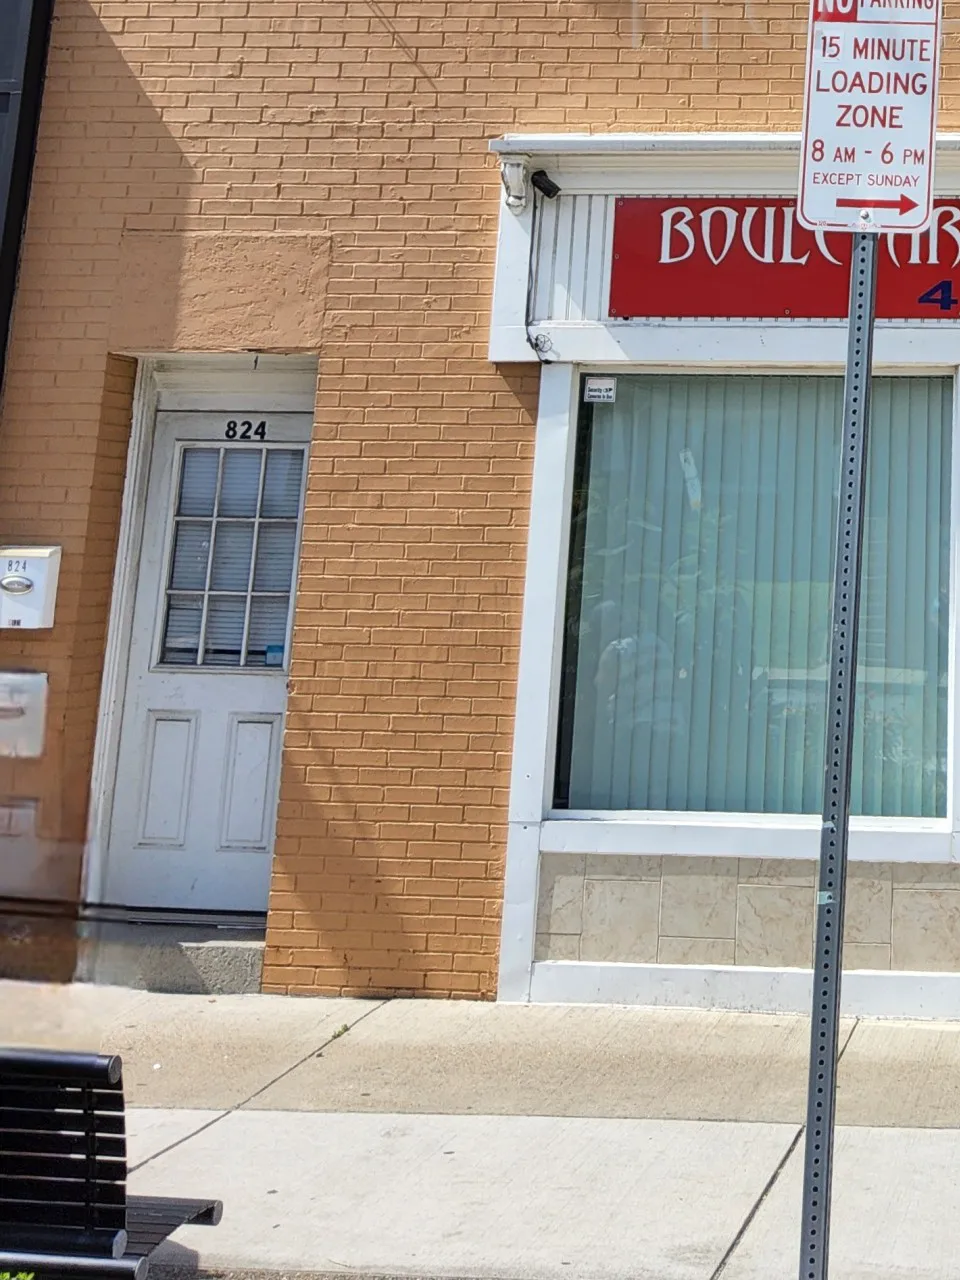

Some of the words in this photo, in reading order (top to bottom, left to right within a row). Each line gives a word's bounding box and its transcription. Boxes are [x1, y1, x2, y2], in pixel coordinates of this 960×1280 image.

[821, 36, 840, 58] 15
[853, 37, 930, 61] MINUTE
[816, 70, 927, 95] LOADING
[836, 105, 903, 128] ZONE
[811, 139, 825, 162] 8
[833, 147, 855, 163] AM
[881, 142, 894, 164] 6
[903, 149, 925, 165] PM
[813, 172, 862, 186] EXCEPT
[867, 174, 920, 187] SUNDAY
[225, 420, 267, 440] 824
[8, 560, 27, 572] 824
